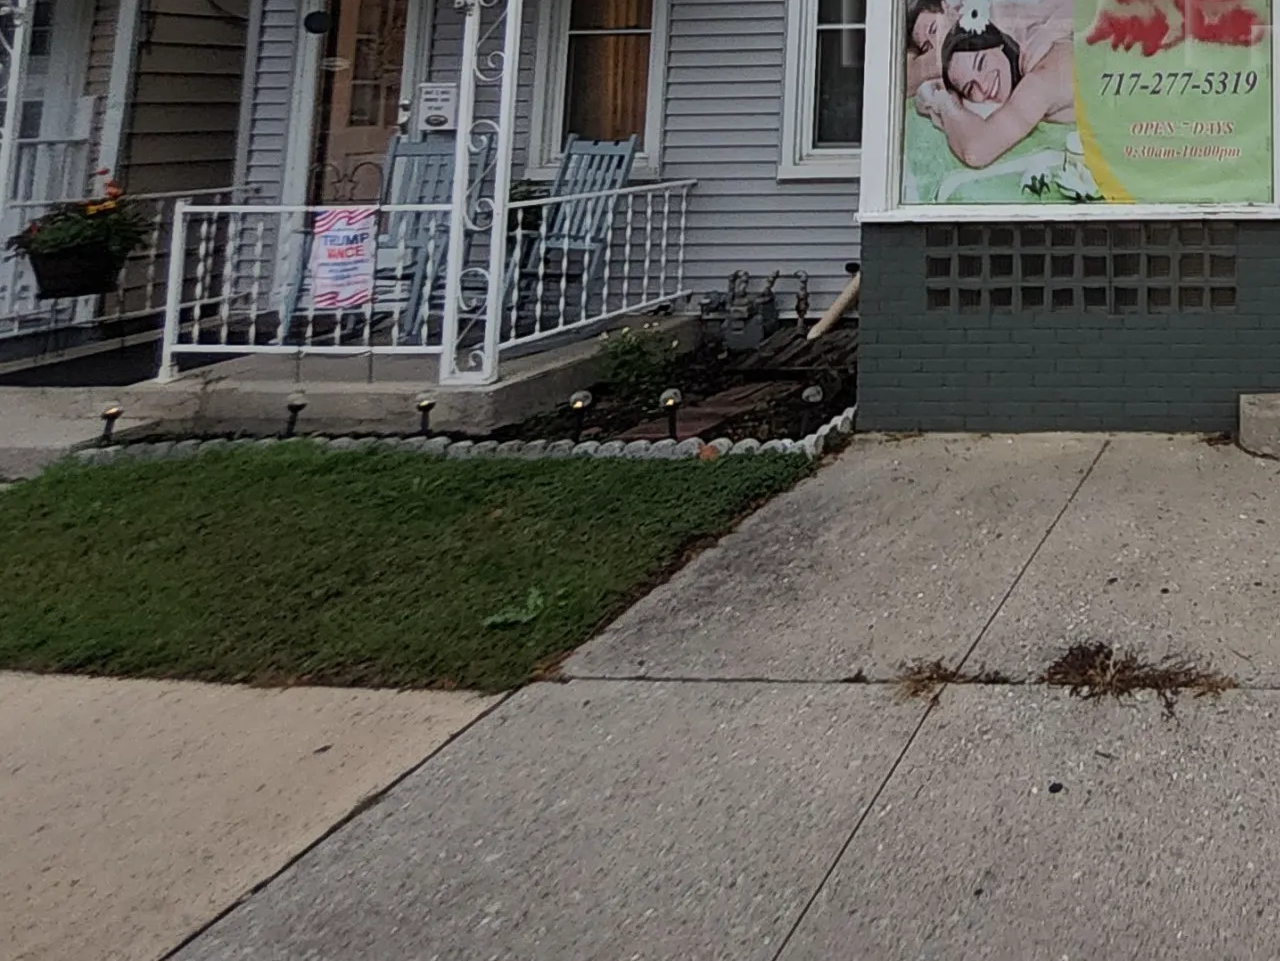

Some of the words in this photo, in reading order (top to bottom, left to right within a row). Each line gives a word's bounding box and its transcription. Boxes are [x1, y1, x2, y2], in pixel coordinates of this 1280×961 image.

[1100, 70, 1258, 96] 717-277-5319
[1130, 121, 1176, 136] OPEN
[1191, 121, 1234, 135] DAYS
[1124, 144, 1241, 162] 9:30am-10:00pm
[320, 232, 369, 246] TRUMP
